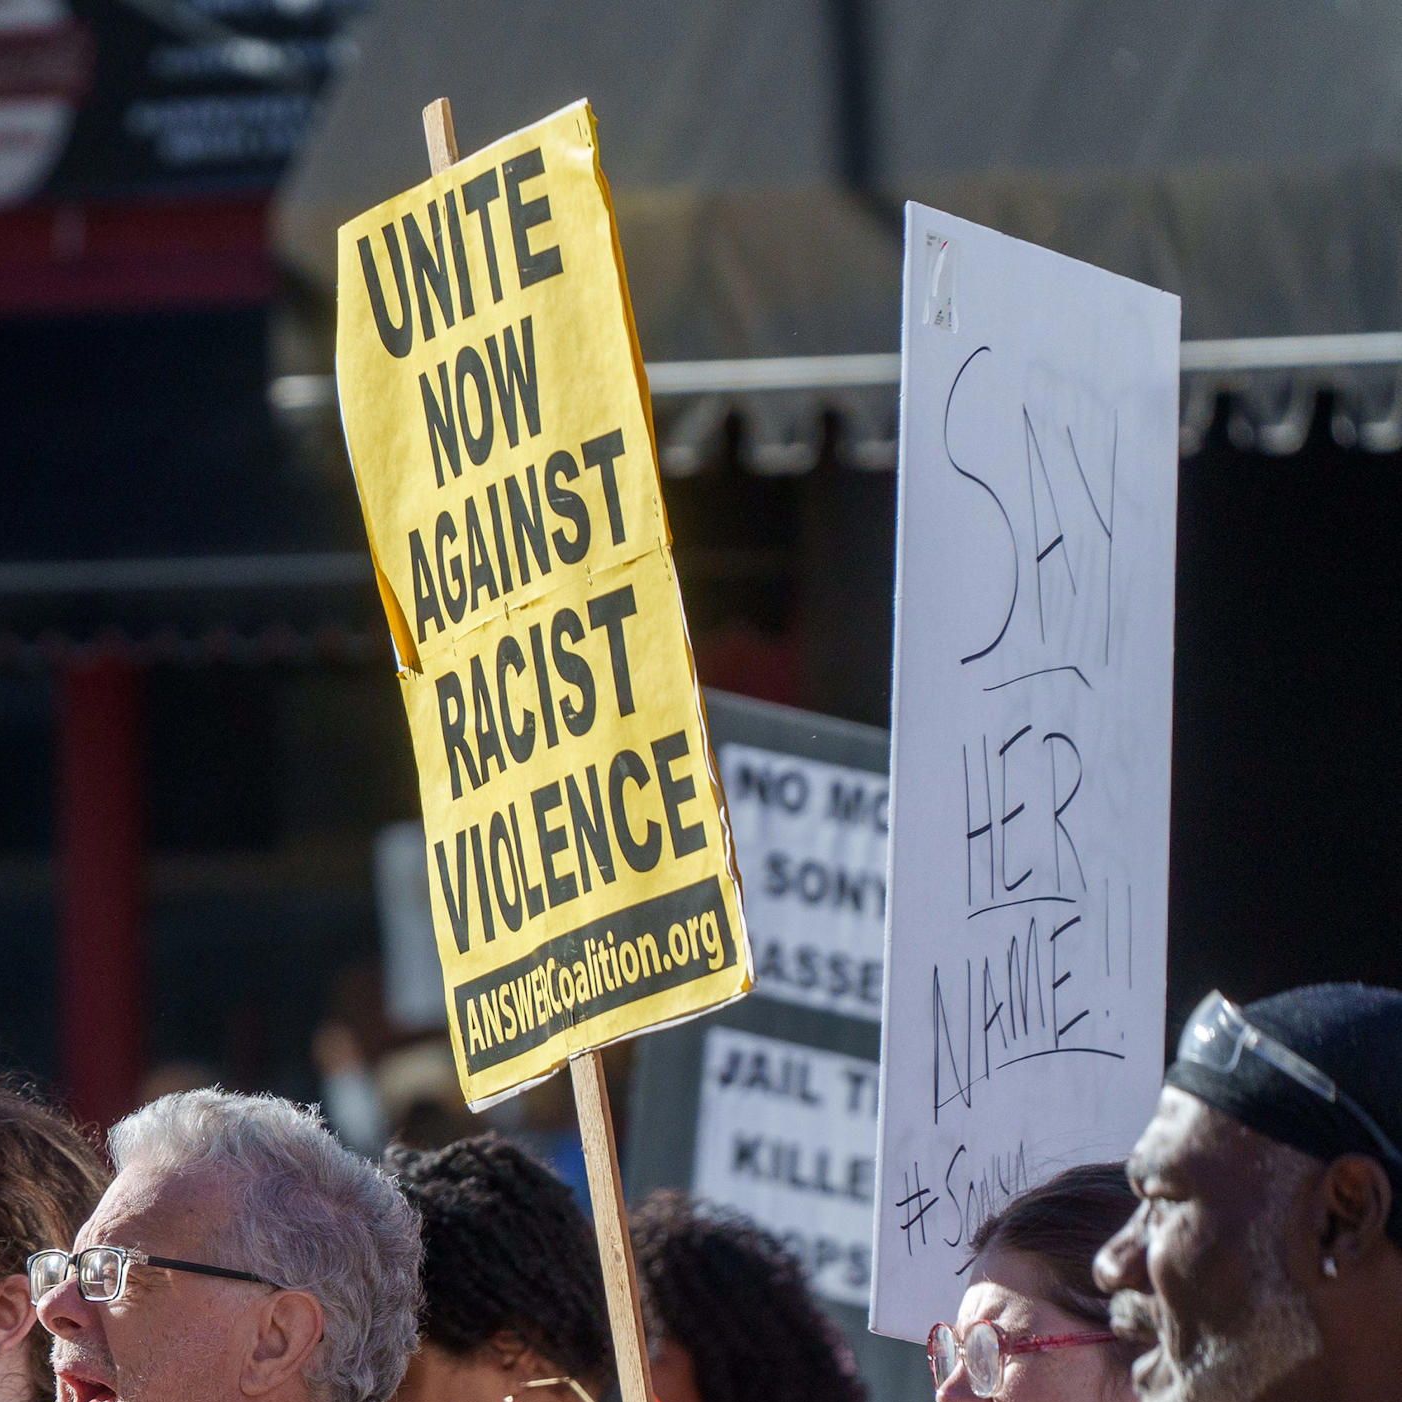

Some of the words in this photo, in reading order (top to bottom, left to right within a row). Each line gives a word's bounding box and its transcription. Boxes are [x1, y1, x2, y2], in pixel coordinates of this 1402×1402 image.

[357, 146, 564, 358] UNITE
[420, 315, 543, 489] NOW
[408, 427, 628, 642] AGAINST
[943, 346, 1119, 665] SAY
[434, 584, 642, 800] RACIST
[735, 758, 810, 816] NO
[434, 730, 710, 955] VIOLENCE
[962, 725, 1087, 906] HER
[466, 909, 725, 1056] ANSWERCoalition.org
[718, 1046, 826, 1105] JAIL
